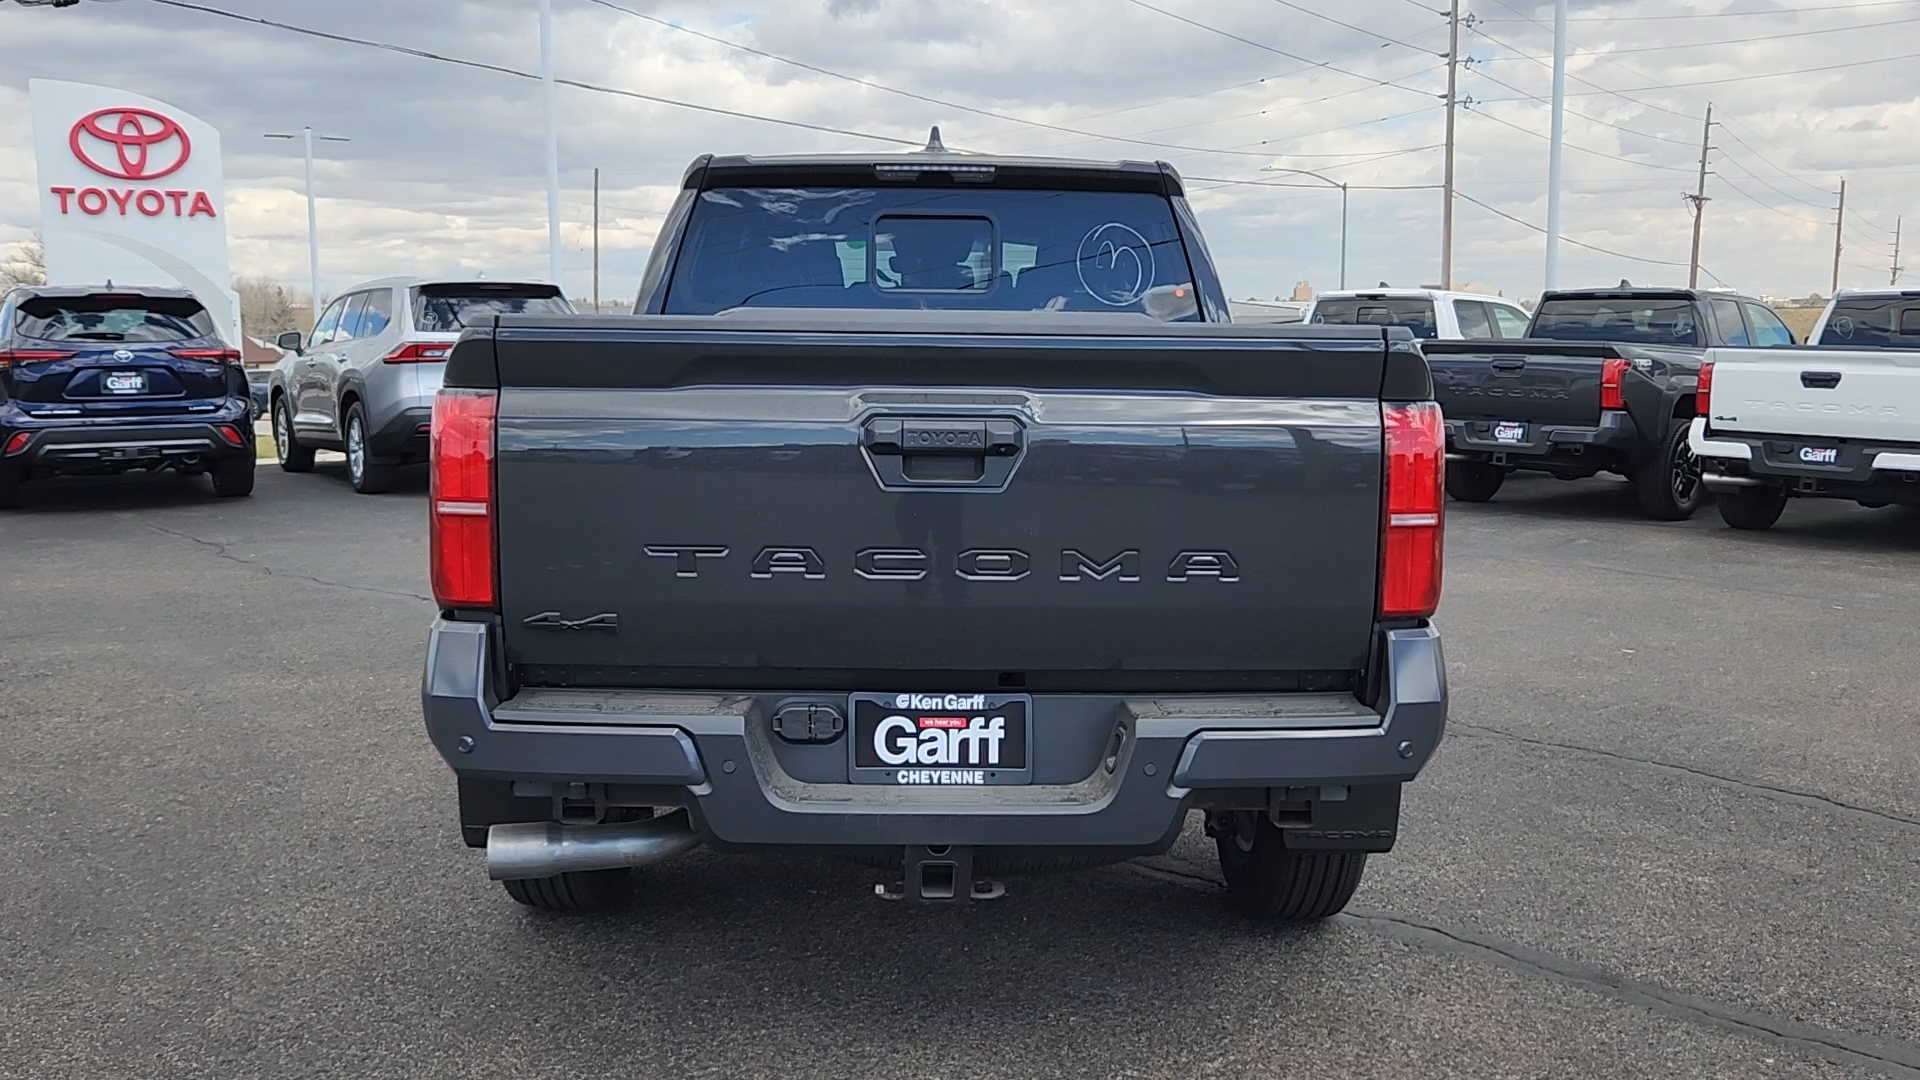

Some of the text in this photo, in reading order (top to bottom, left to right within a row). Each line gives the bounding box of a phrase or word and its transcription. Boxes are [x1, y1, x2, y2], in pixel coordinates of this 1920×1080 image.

[50, 186, 217, 218] TOYOTA
[106, 376, 143, 389] Garff
[1448, 386, 1569, 399] TACOMA
[1743, 399, 1901, 417] TACOMA
[906, 430, 982, 446] TOYOTA
[1494, 426, 1524, 440] Garff
[1799, 446, 1837, 463] Garff
[643, 543, 1240, 583] TACOMA
[522, 611, 618, 632] 4x4
[911, 694, 985, 711] Ken Garff
[874, 715, 1005, 765] Garff
[897, 770, 985, 785] CHEYENNE
